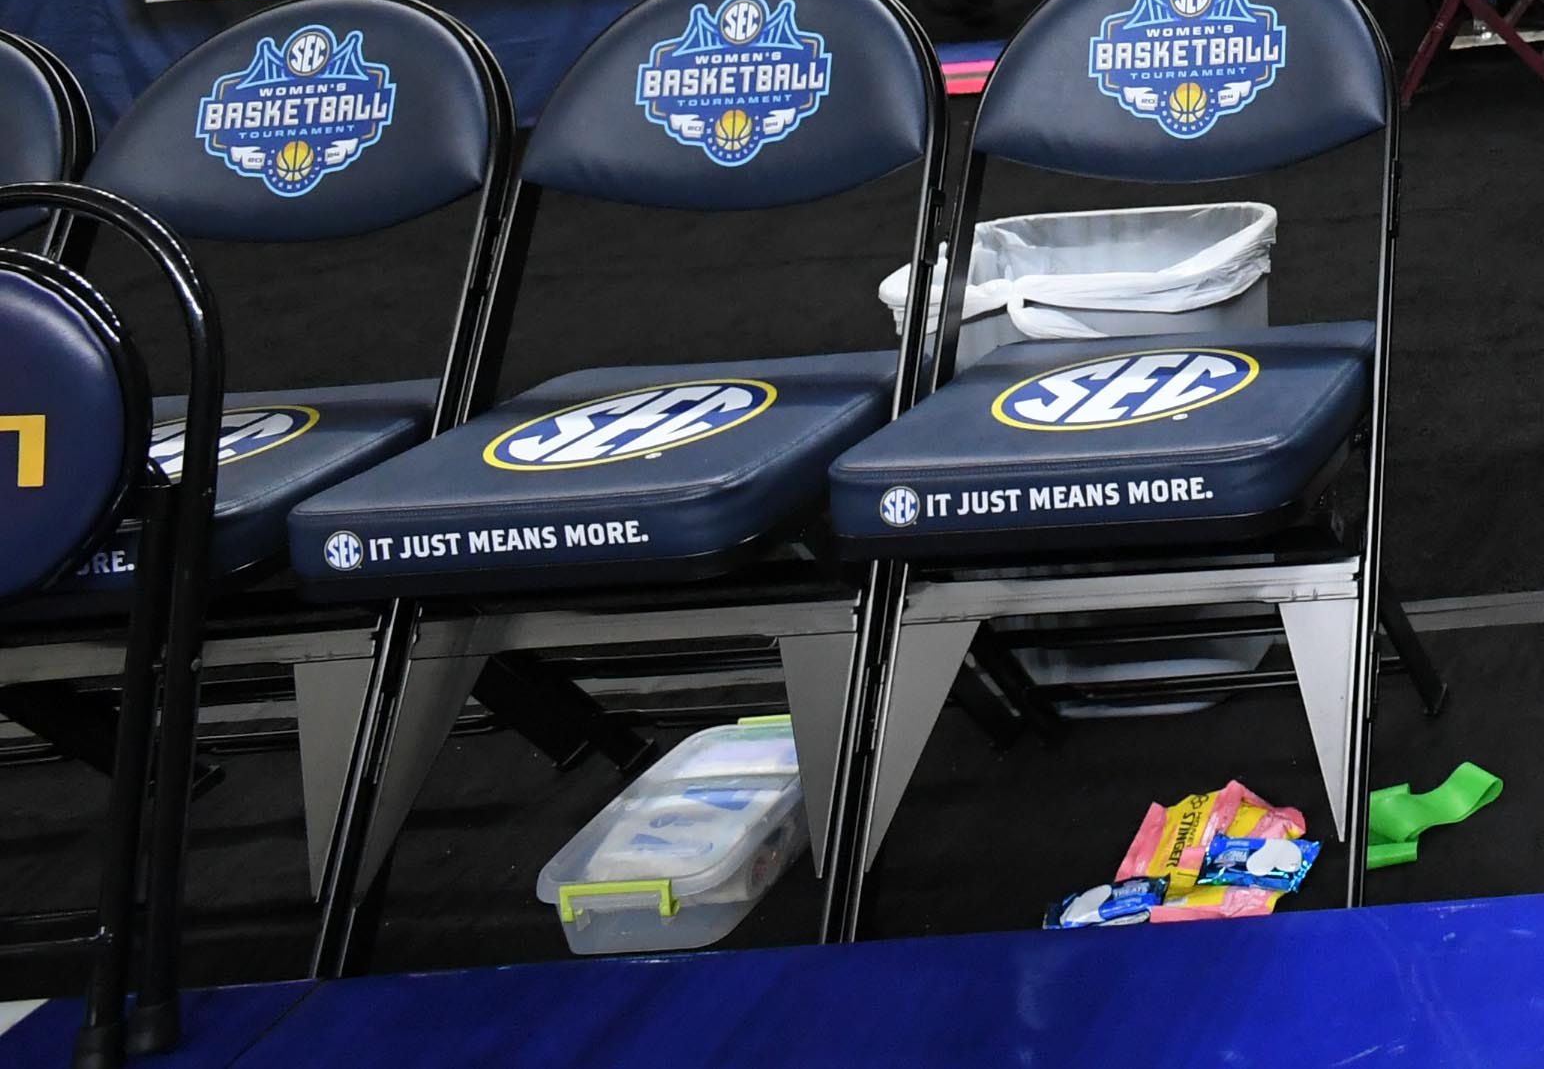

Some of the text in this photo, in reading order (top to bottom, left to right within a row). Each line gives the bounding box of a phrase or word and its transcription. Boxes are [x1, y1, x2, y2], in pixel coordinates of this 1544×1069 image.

[724, 2, 760, 40] SEC
[1146, 24, 1234, 38] WOMEN'S
[291, 35, 326, 73] SEC
[695, 51, 782, 65] WOMEN'S
[1096, 35, 1279, 70] BASKETBALL
[259, 82, 347, 97] WOMEN'S
[643, 62, 824, 98] BASKETBALL
[1130, 67, 1247, 80] TOURNAMENT
[204, 92, 387, 131] BASKETBALL
[677, 94, 792, 107] TOURNAMENT
[238, 124, 355, 140] TOURNAMENT
[1013, 353, 1237, 423] SEC
[508, 385, 754, 463] SEC
[883, 477, 1214, 525] SEC IT JUST MEANS MORE.
[327, 520, 649, 569] SEC IT JUST MEANS MORE.
[1166, 811, 1196, 868] STINGER
